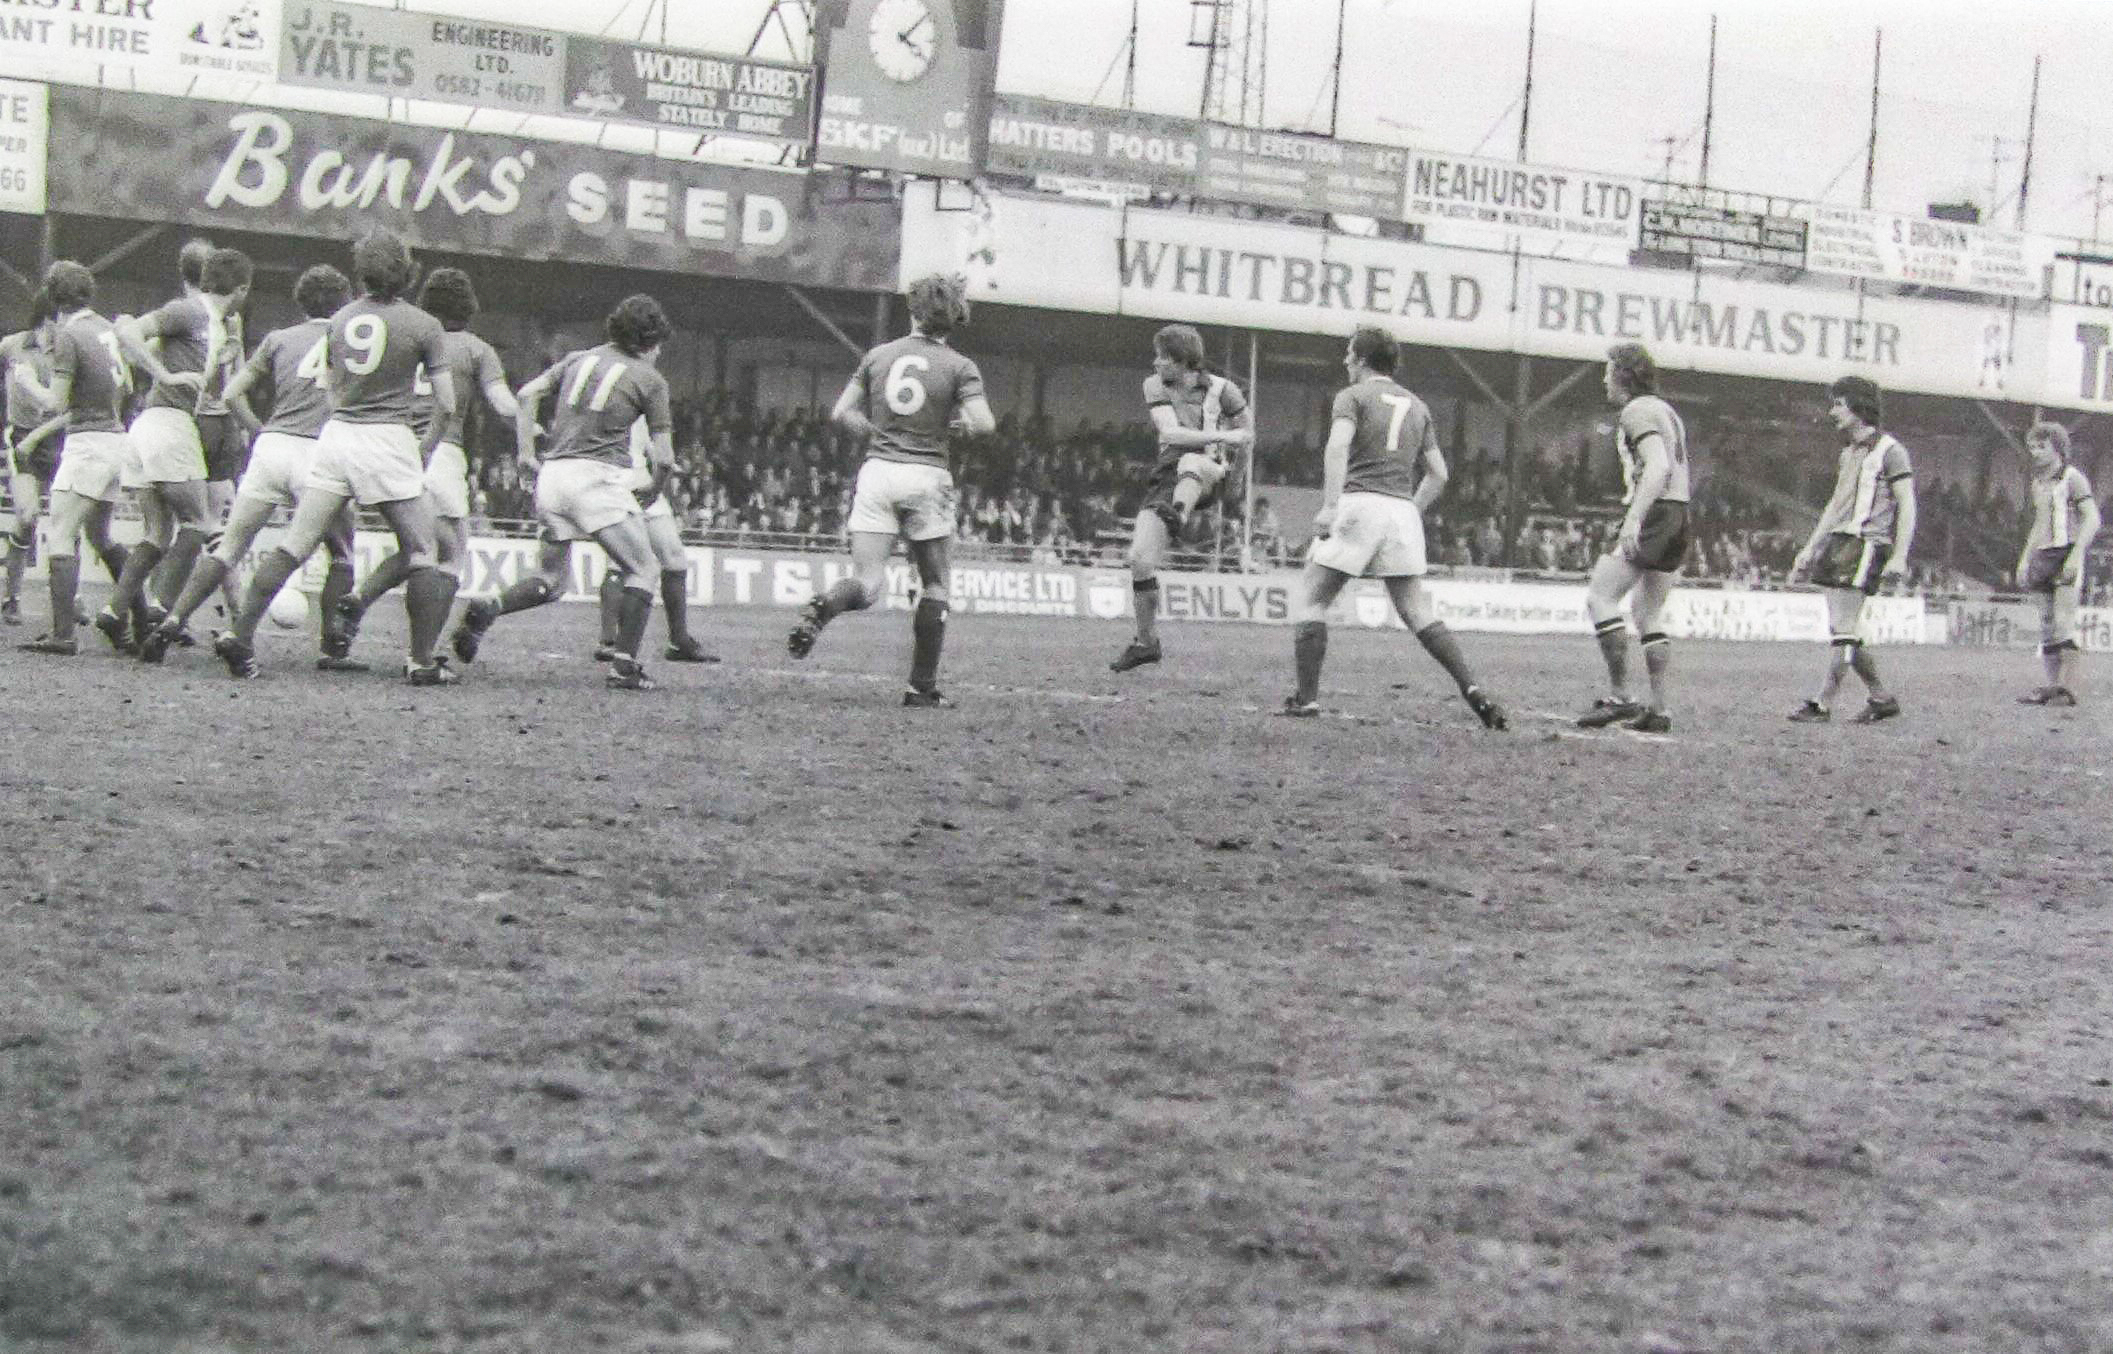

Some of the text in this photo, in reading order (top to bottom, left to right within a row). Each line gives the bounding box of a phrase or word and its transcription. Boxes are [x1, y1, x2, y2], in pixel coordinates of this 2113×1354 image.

[70, 23, 151, 56] HIRE
[292, 10, 363, 38] J.R.
[431, 22, 555, 57] ENGINEERING
[292, 35, 416, 87] YATES
[475, 54, 515, 75] LTD.
[633, 50, 811, 100] WOBURN ABBEY
[658, 104, 730, 128] STATELY
[819, 117, 898, 151] SKF
[988, 118, 1198, 167] HATTERS POOLS
[566, 171, 789, 247] SEED
[1414, 158, 1568, 213] NEAHURST
[1582, 180, 1633, 221] LTD
[1909, 221, 1968, 251] BROWN
[1115, 237, 1902, 366] WHITBREAD BREWMASTER
[344, 313, 389, 375] 9
[567, 354, 628, 412] 11
[885, 354, 930, 416] 6
[1380, 393, 1412, 452] 7
[949, 568, 1032, 602] ERVICE
[1036, 573, 1077, 604] LTD
[1157, 583, 1289, 620] ENLYS
